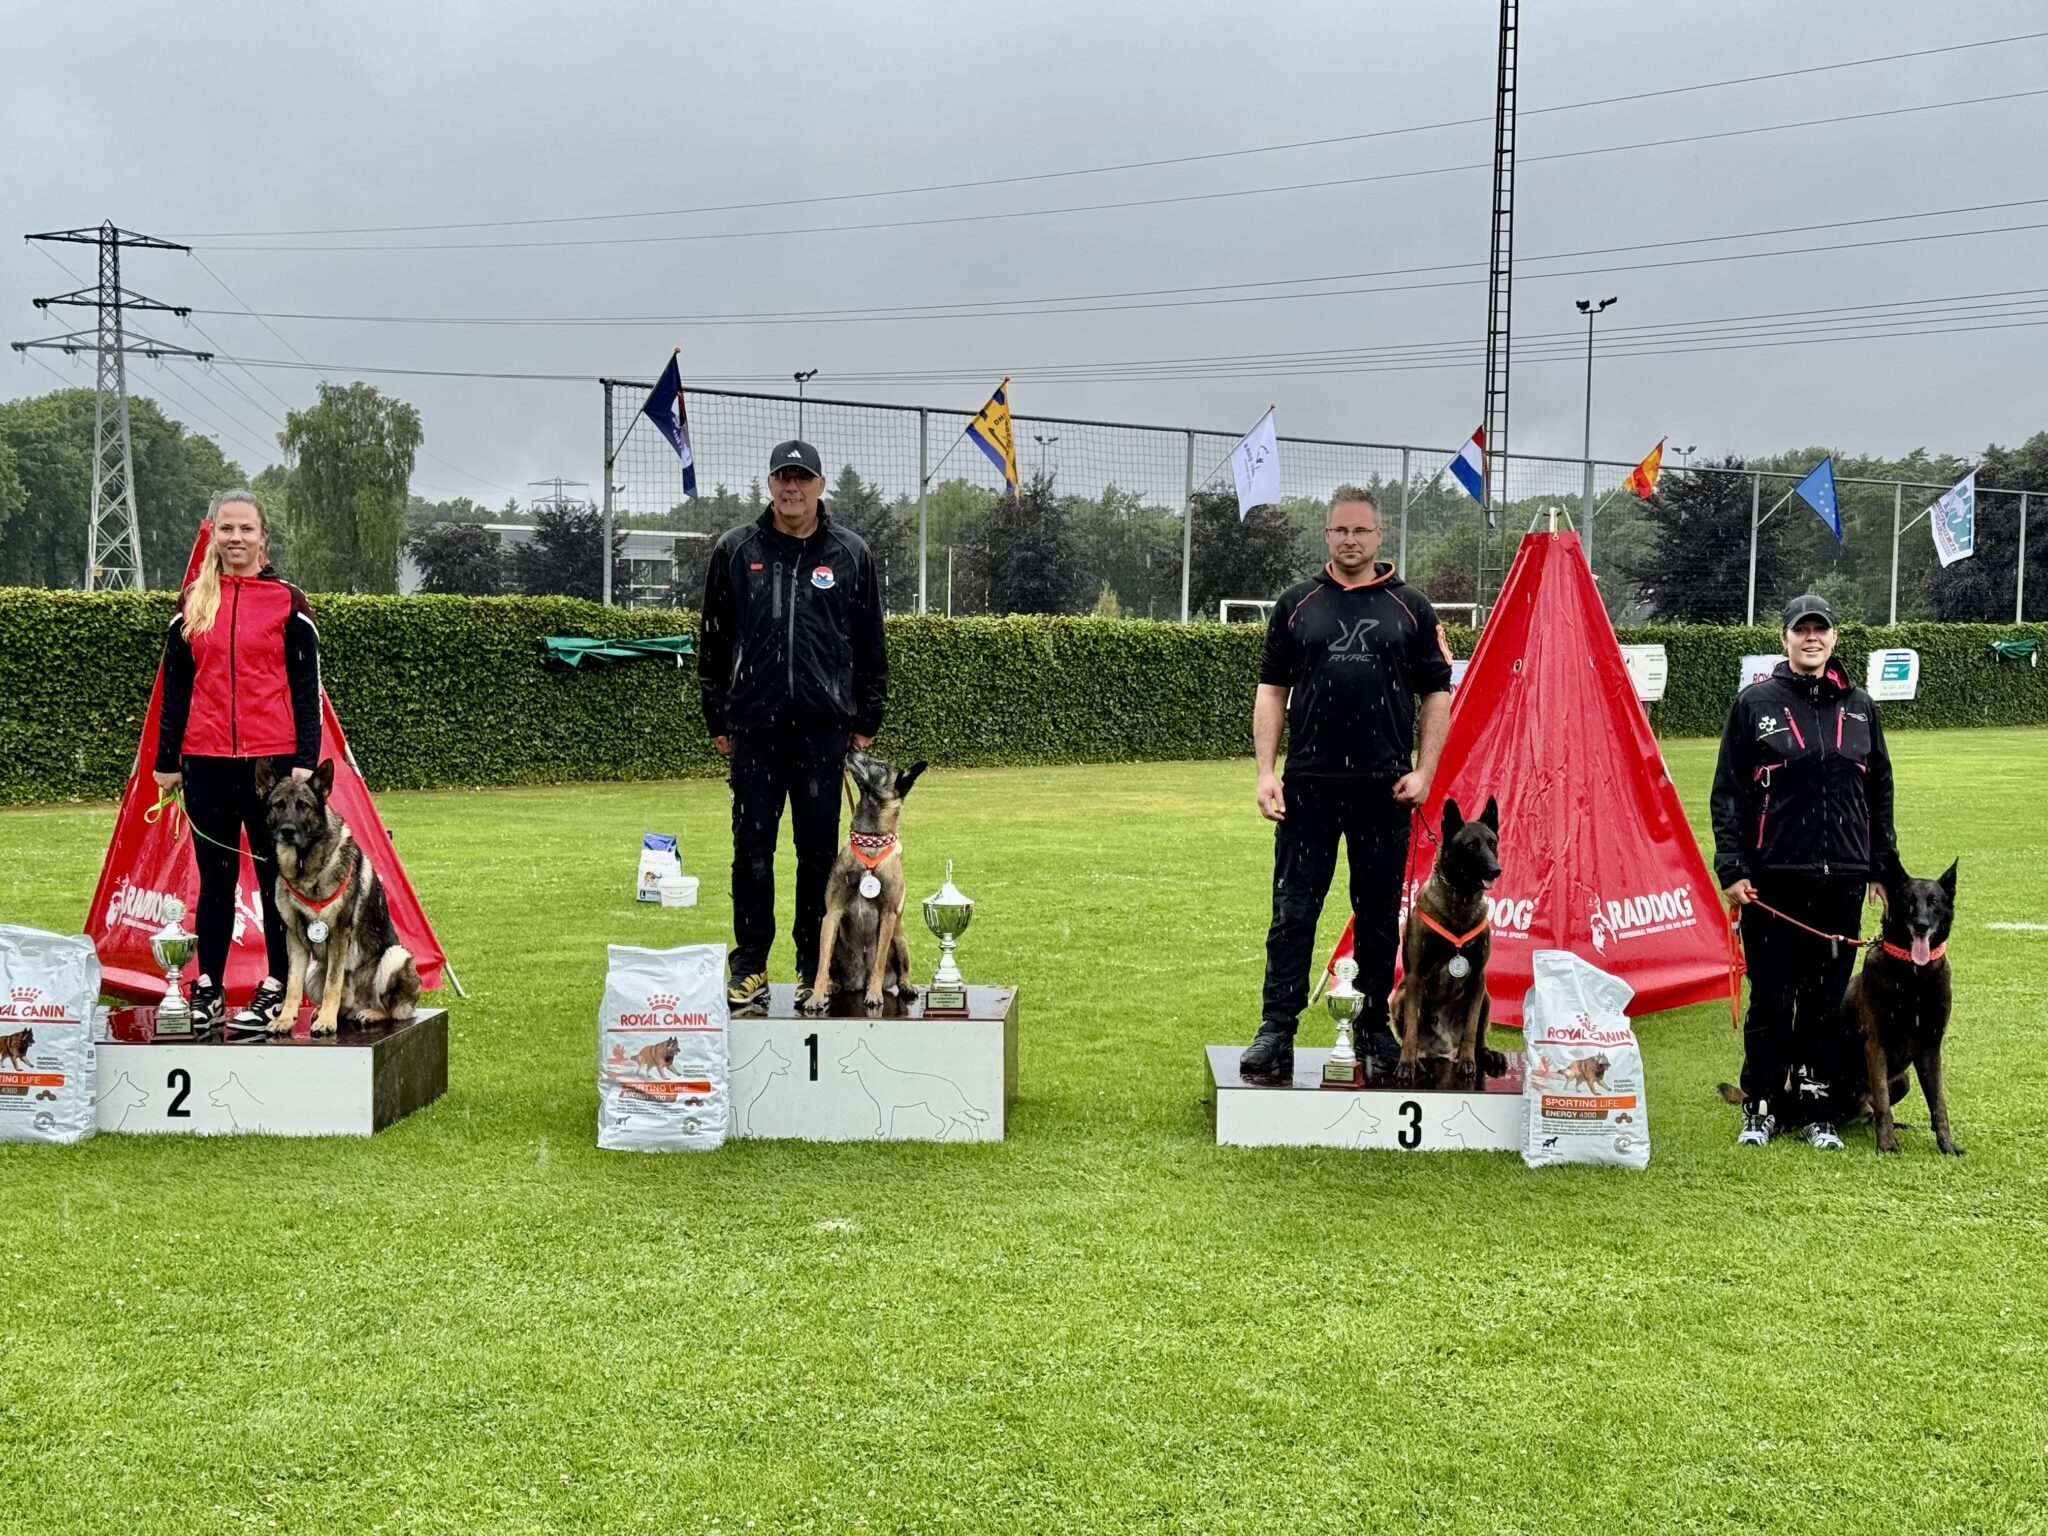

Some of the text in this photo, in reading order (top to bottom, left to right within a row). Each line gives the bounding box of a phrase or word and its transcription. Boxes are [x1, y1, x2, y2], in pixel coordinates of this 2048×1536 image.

[1329, 654, 1373, 662] RVRC
[1753, 672, 1770, 684] ROY
[1483, 896, 1534, 931] DOG
[1606, 887, 1694, 931] RADDOG
[22, 1004, 65, 1018] CANIN
[620, 1013, 708, 1026] ROYAL CANIN
[1547, 1026, 1632, 1043] ROYAL CANIN
[804, 1033, 818, 1081] 1
[21, 1075, 41, 1084] LIFE
[167, 1068, 191, 1117] 2
[1545, 1097, 1620, 1108] SPORTING LIFE
[1545, 1109, 1597, 1119] ENERGY 4300
[1398, 1100, 1422, 1149] 3
